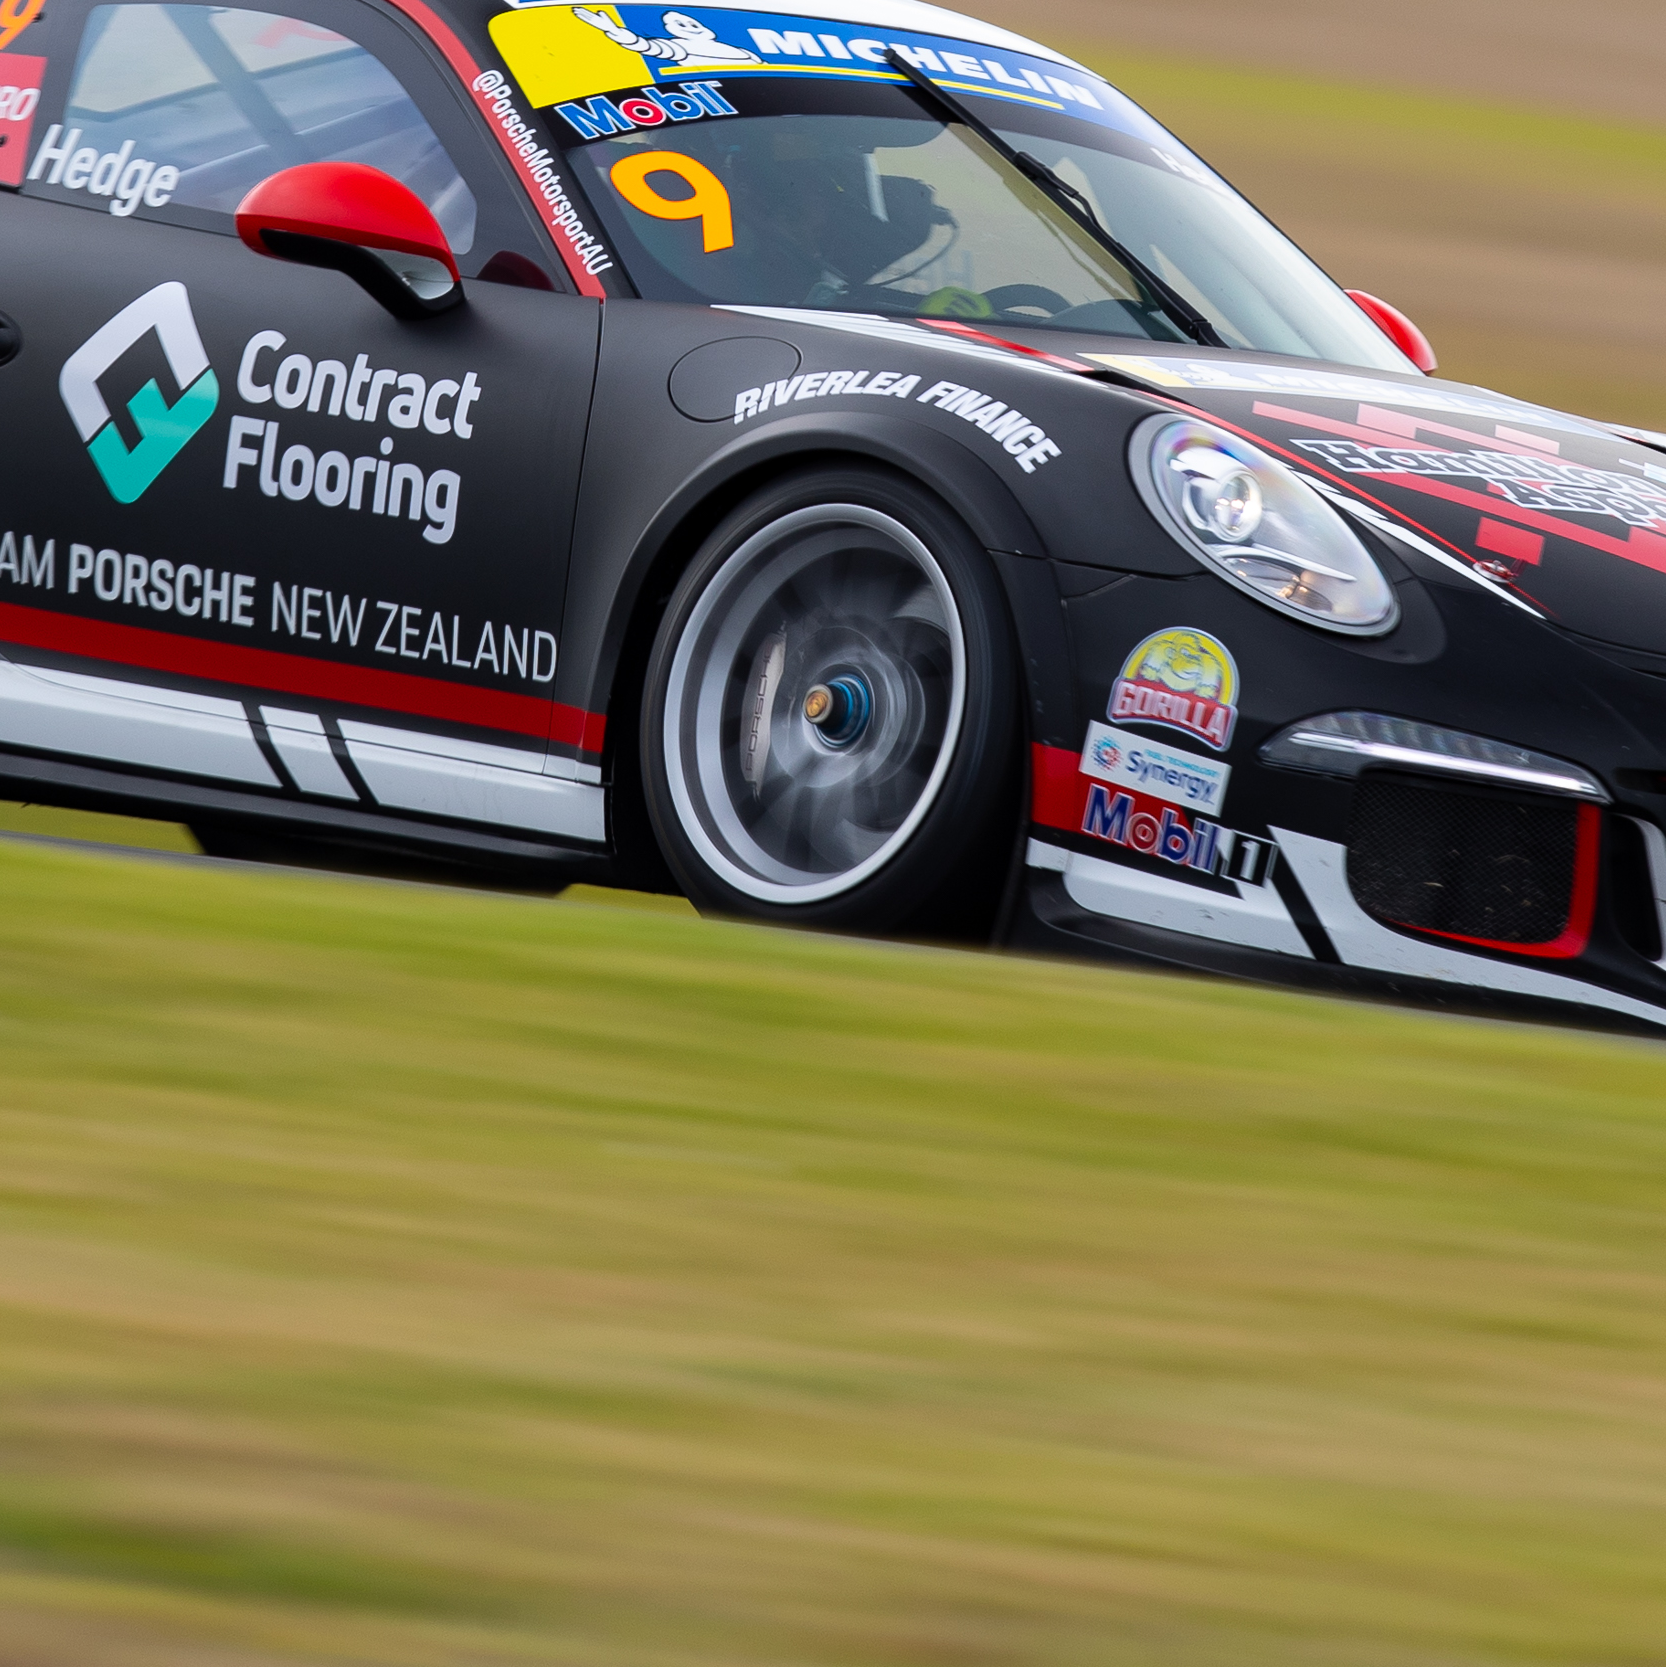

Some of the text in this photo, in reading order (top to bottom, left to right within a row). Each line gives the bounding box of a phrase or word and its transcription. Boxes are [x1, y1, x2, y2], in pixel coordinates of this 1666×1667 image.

[554, 81, 738, 140] Mobil
[747, 28, 1104, 110] MICHELIN
[26, 124, 181, 216] Hedge
[473, 69, 613, 275] @PorscheMotorsportAU
[610, 151, 733, 252] 9
[237, 330, 482, 439] Contract
[734, 371, 1062, 474] RIVERLEA FINANCE
[1255, 373, 1553, 424] MICHELIN
[223, 415, 461, 544] Flooring
[68, 544, 256, 626] PORSCHE
[271, 581, 367, 647] NEW
[374, 600, 557, 684] ZEALAND
[1114, 682, 1228, 745] GORILLA
[1126, 750, 1219, 805] Synergy
[1082, 783, 1220, 875] Mobil
